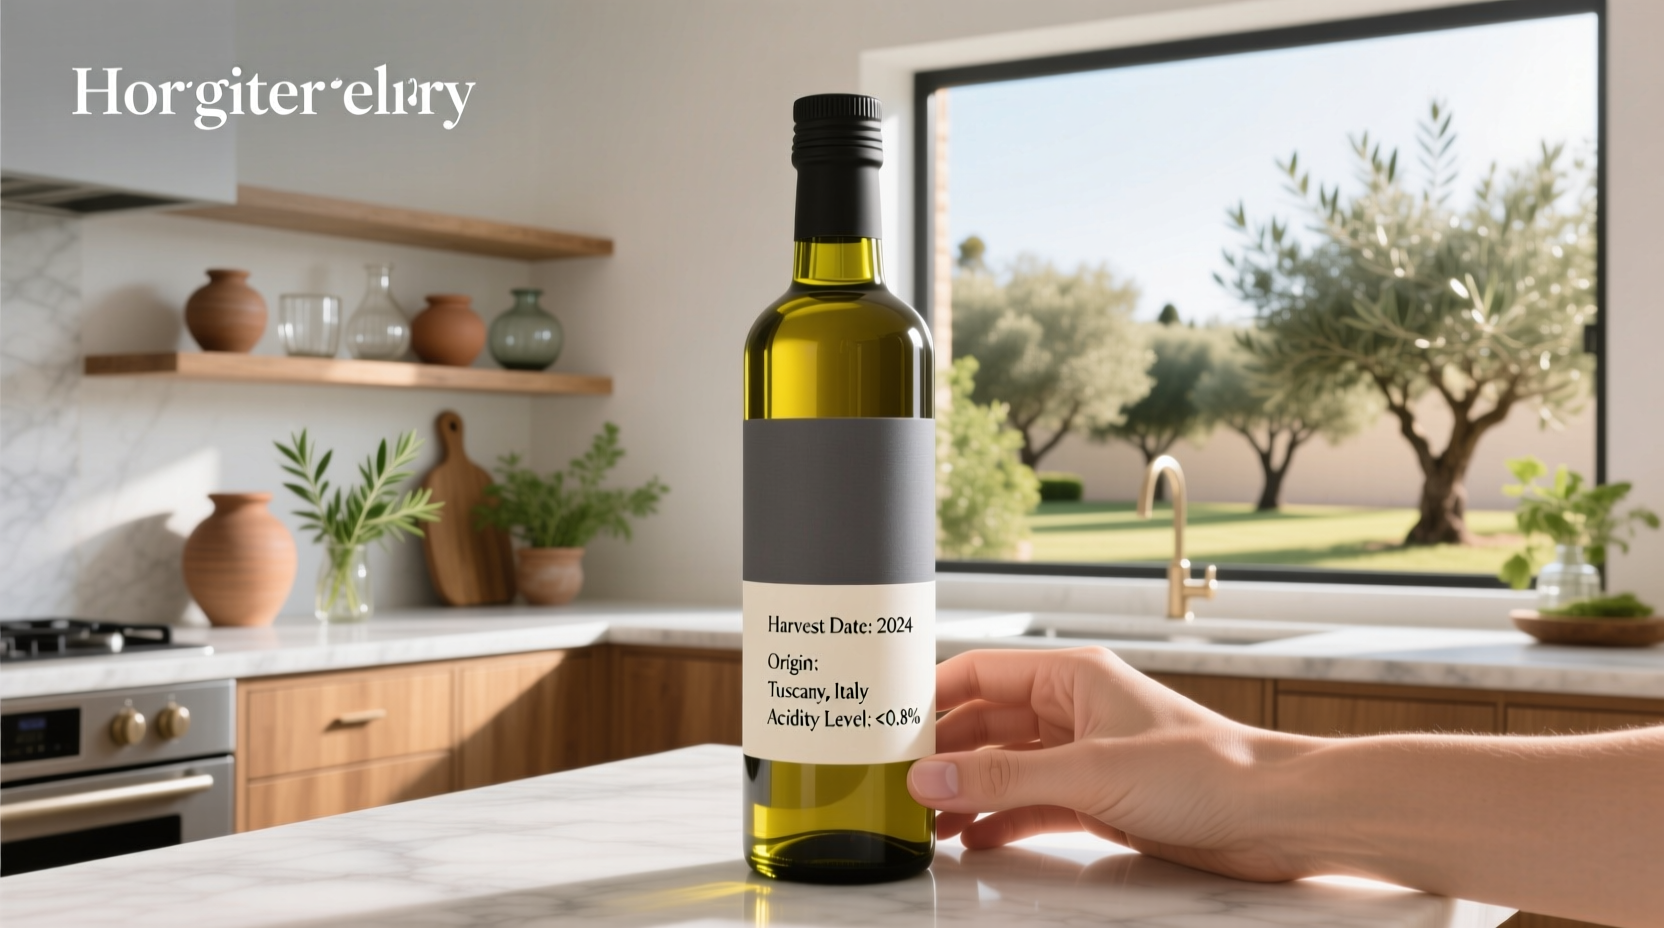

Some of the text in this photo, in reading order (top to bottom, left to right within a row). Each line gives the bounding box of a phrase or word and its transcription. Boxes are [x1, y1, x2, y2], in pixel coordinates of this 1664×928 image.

[768, 615, 913, 634] Harvest Date: 2024
[767, 652, 819, 676] Origin:
[768, 680, 869, 704] Tuscany, Italy
[767, 707, 921, 731] Acidity Level: <0.8%
